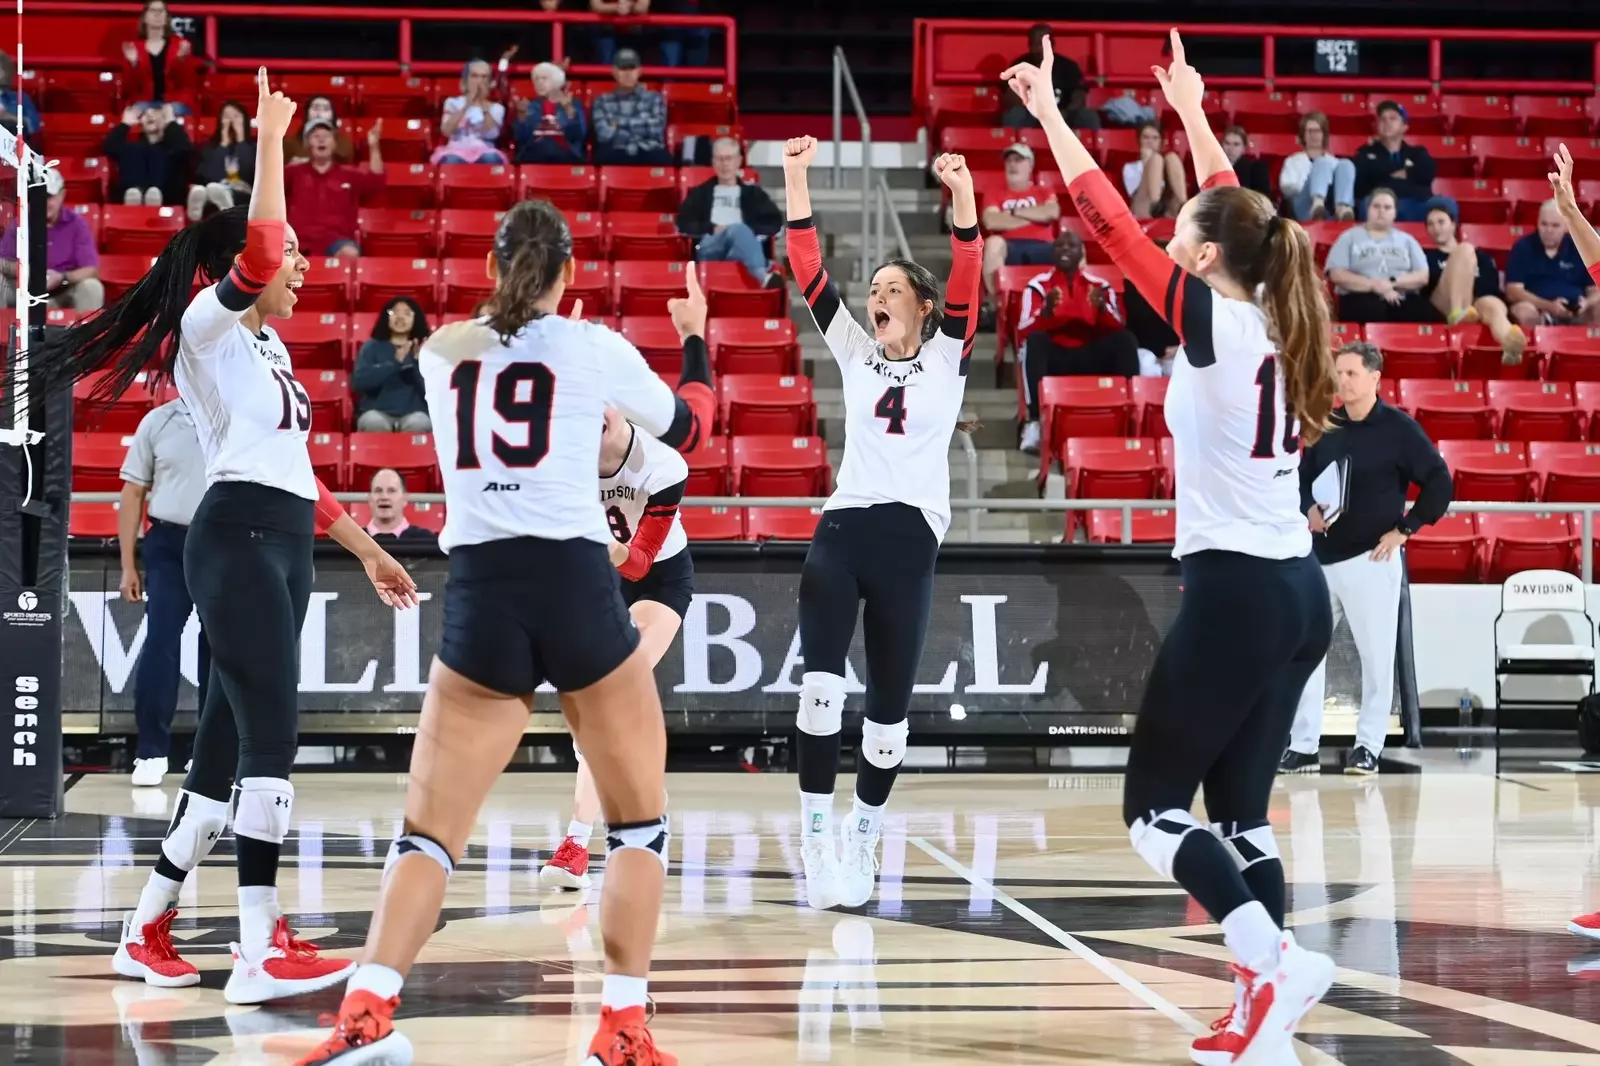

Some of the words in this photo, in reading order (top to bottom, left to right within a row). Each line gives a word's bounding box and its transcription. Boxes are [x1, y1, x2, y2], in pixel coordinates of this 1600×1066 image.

[1316, 39, 1358, 55] SECT.
[1327, 54, 1347, 72] 12
[449, 359, 556, 470] 19
[874, 385, 907, 435] 4
[600, 485, 636, 502] IDSON
[1513, 583, 1573, 595] DAVIDSON
[1048, 725, 1127, 735] DAKTRONICS
